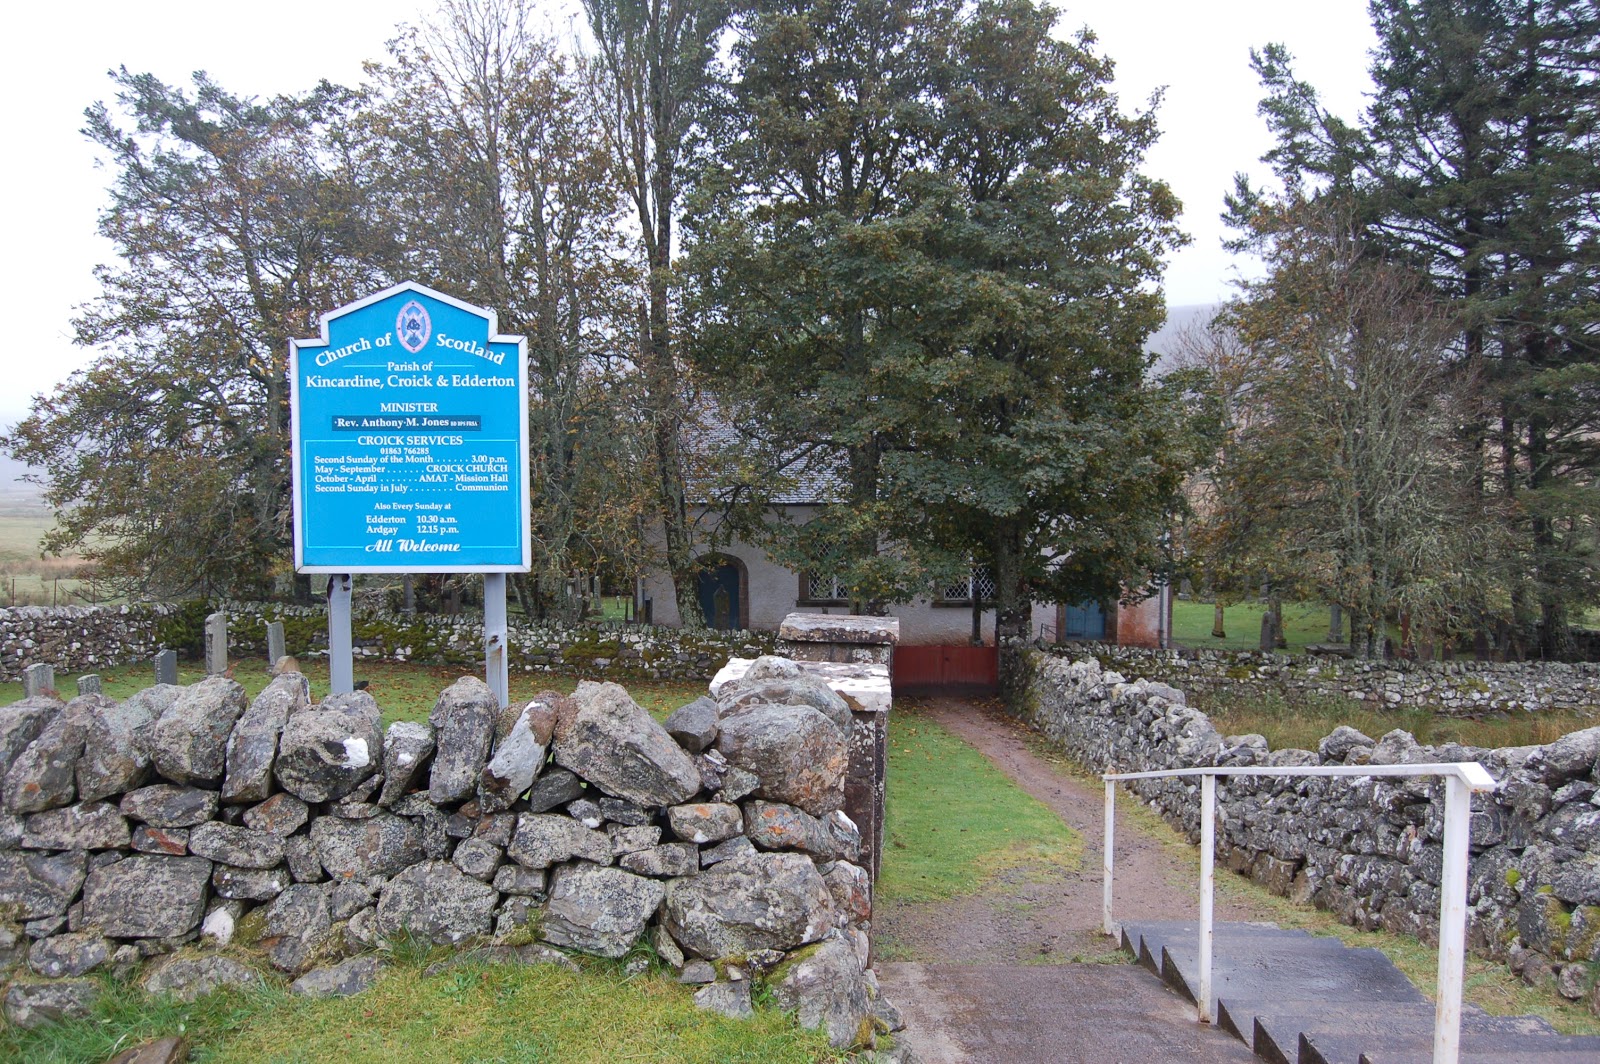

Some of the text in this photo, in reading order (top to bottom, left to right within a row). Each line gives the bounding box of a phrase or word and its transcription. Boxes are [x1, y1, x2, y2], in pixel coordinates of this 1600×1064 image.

[315, 333, 506, 367] Church of Scotland
[387, 362, 433, 371] Parish of
[306, 374, 515, 389] Kincardine, Croick & Edderton
[380, 403, 438, 412] MINISTER
[337, 418, 358, 427] Rev.
[362, 418, 403, 429] Anthony
[406, 418, 419, 427] M.
[422, 418, 449, 426] Jones
[358, 435, 463, 446] CROICK SERVICES
[346, 456, 378, 465] Sunday
[405, 455, 433, 463] Month
[489, 456, 507, 465] p.m.
[315, 466, 334, 474] May
[340, 465, 385, 474] September
[355, 475, 377, 484] April
[455, 474, 488, 482] Mission
[347, 484, 378, 494] Sunday
[390, 484, 408, 494] July
[392, 503, 413, 512] Every
[415, 502, 443, 512] Sunday
[366, 515, 406, 524] Edderton
[416, 516, 438, 524] 10.30
[366, 526, 398, 535] Ardgay
[365, 539, 461, 552] All Welcome
